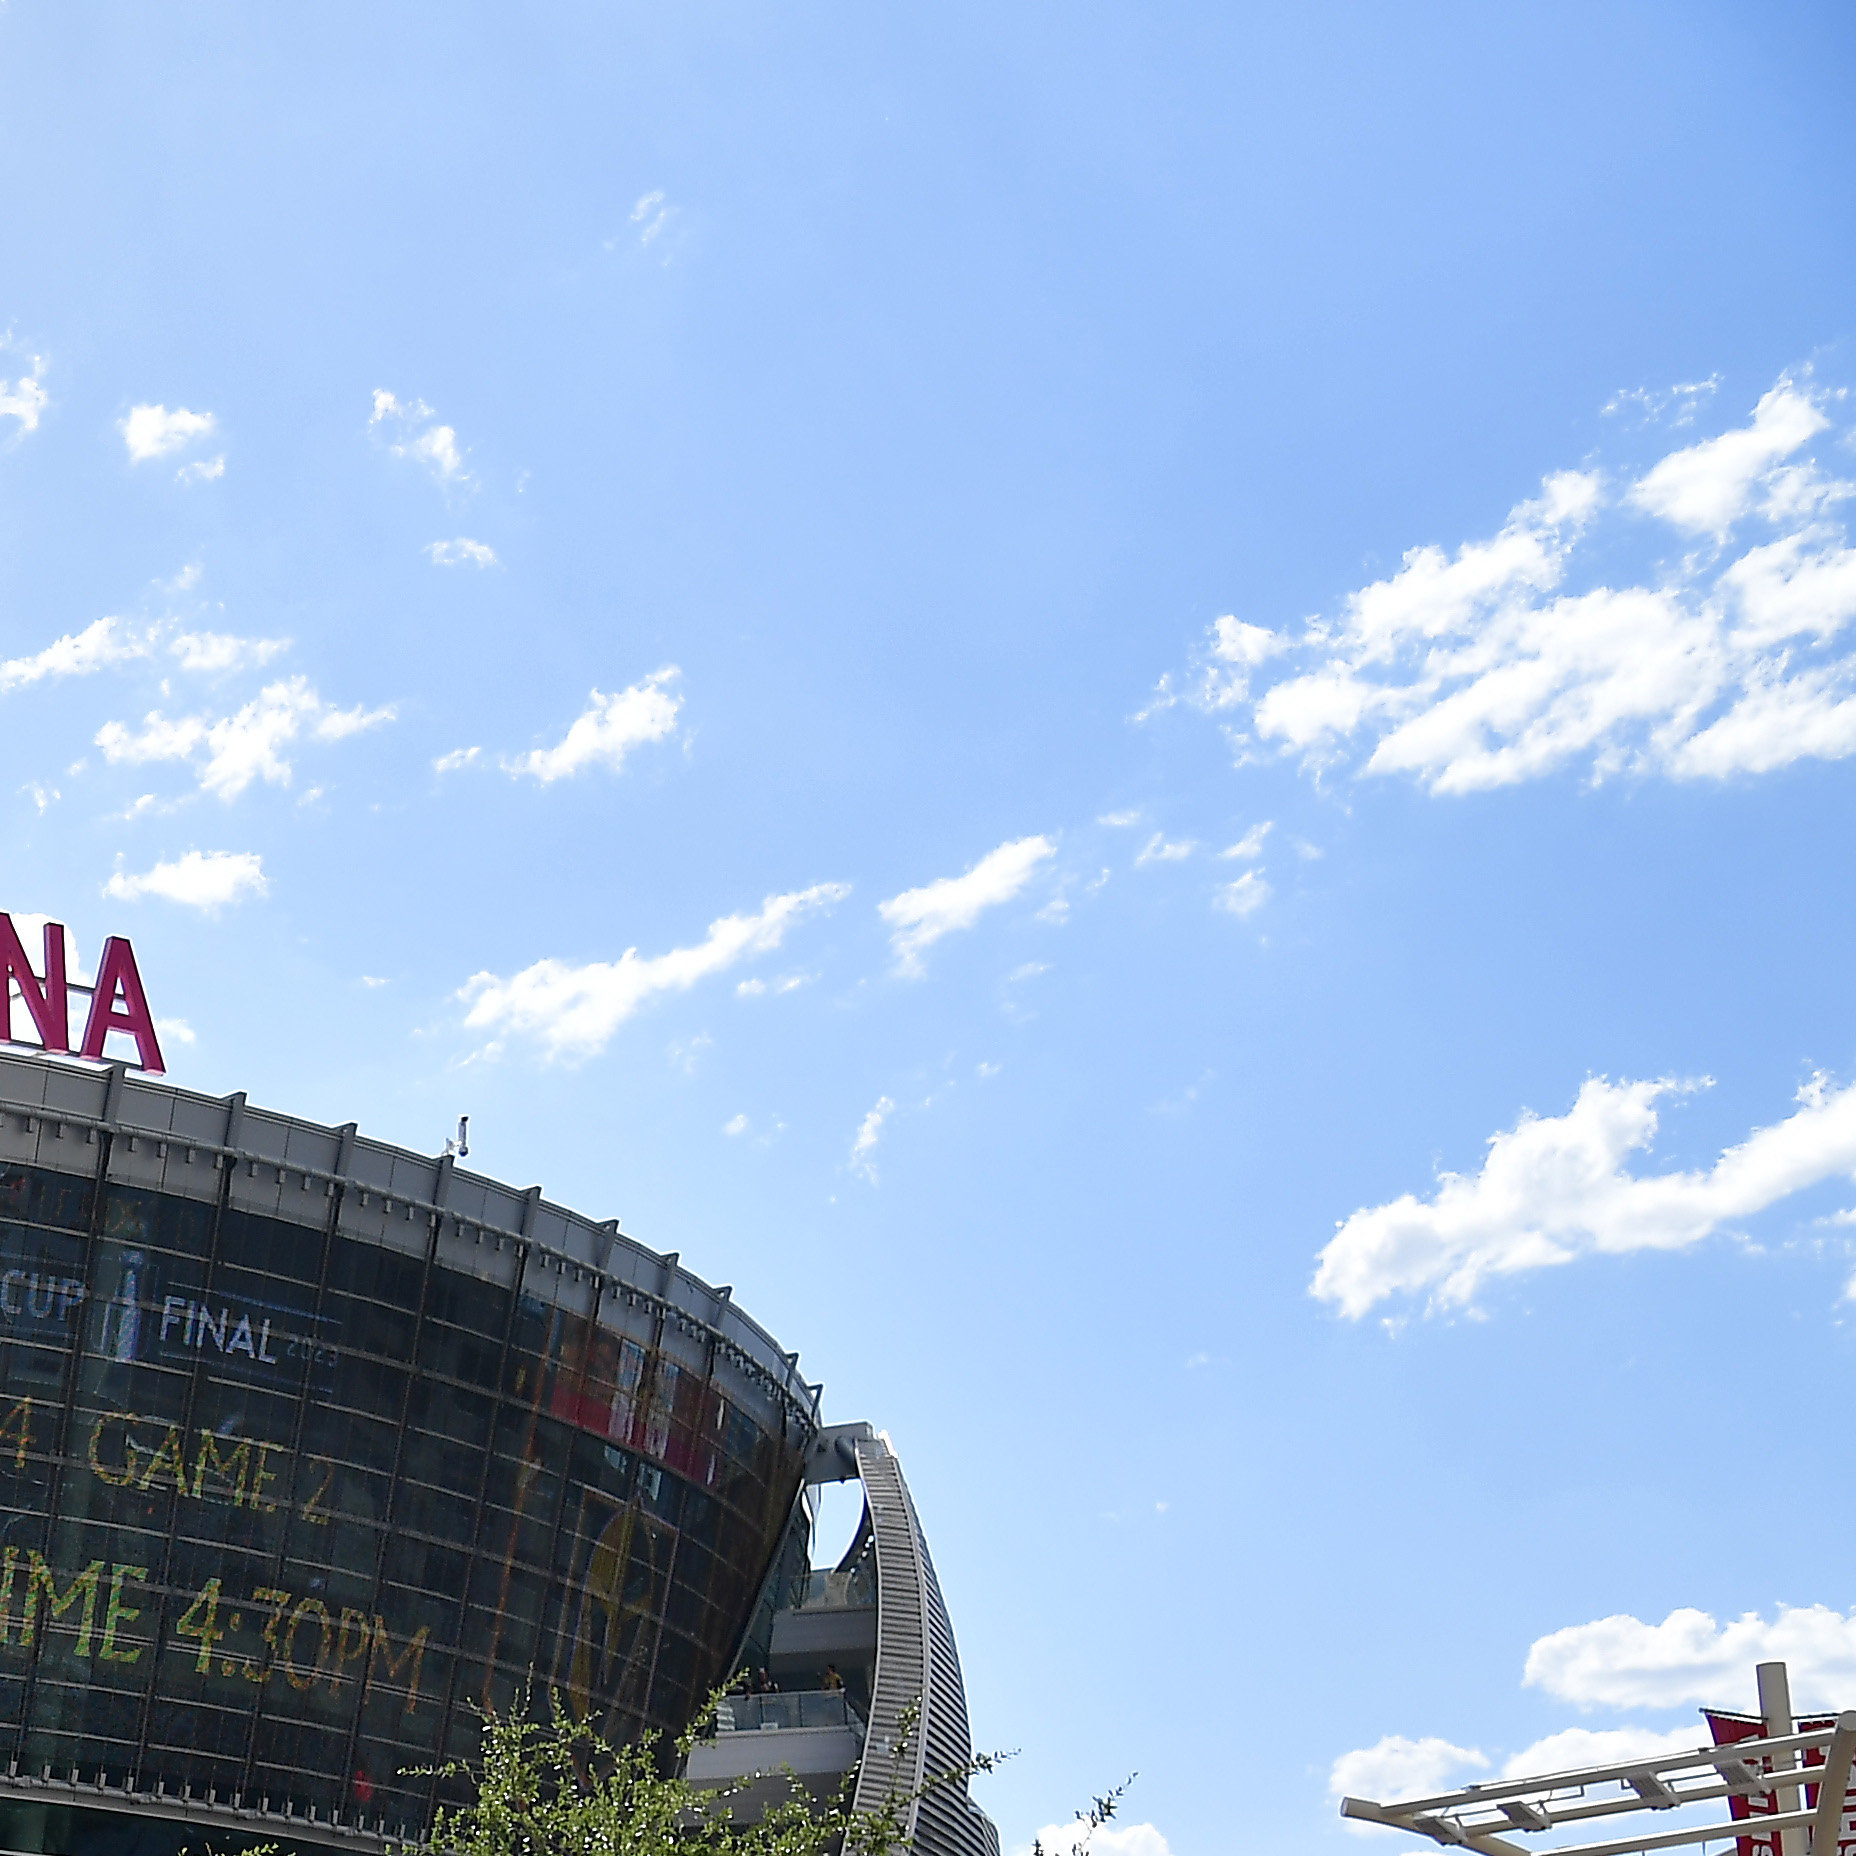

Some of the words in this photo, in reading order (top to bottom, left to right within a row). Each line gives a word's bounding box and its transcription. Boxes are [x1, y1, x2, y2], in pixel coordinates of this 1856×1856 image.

[0, 1268, 86, 1322] CUP
[159, 1295, 278, 1365] FINAL
[88, 1411, 284, 1513] GAME
[175, 1576, 431, 1716] 4:30PM
